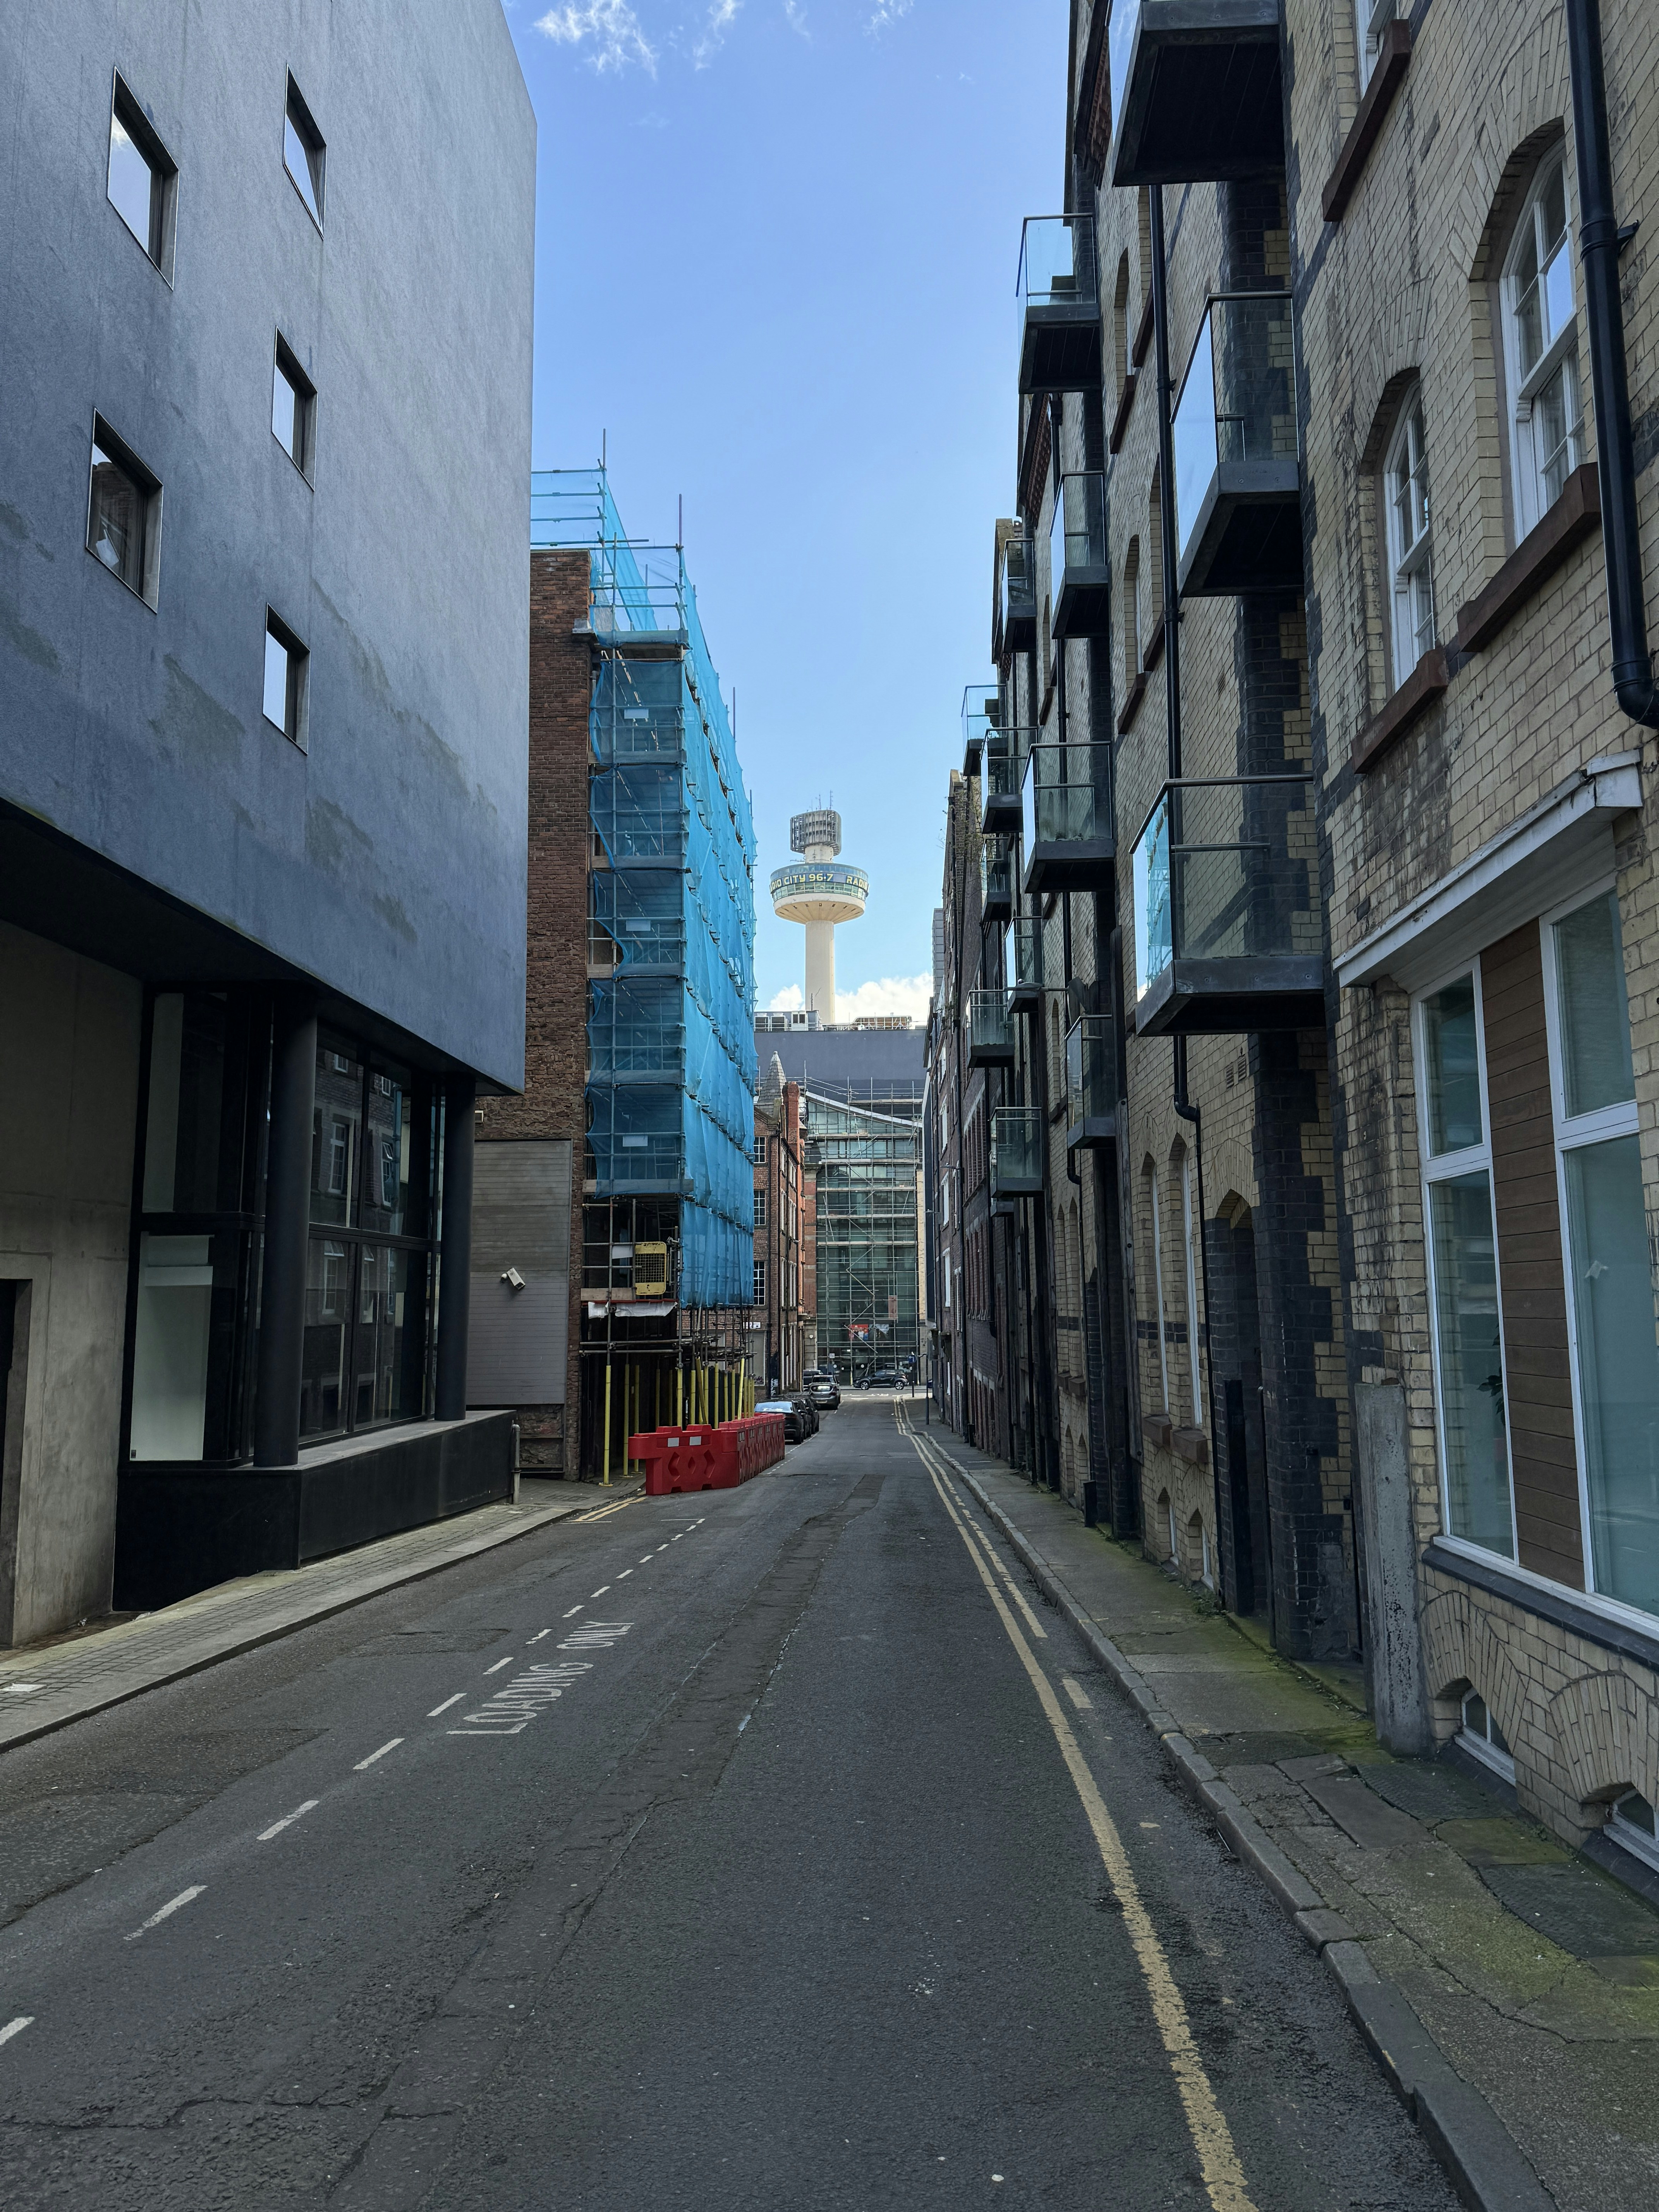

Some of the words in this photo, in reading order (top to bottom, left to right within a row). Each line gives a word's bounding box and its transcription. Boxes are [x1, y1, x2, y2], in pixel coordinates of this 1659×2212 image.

[784, 874, 805, 885] CITY
[446, 1662, 593, 1734] LOADING
[556, 1621, 634, 1649] ONLY
